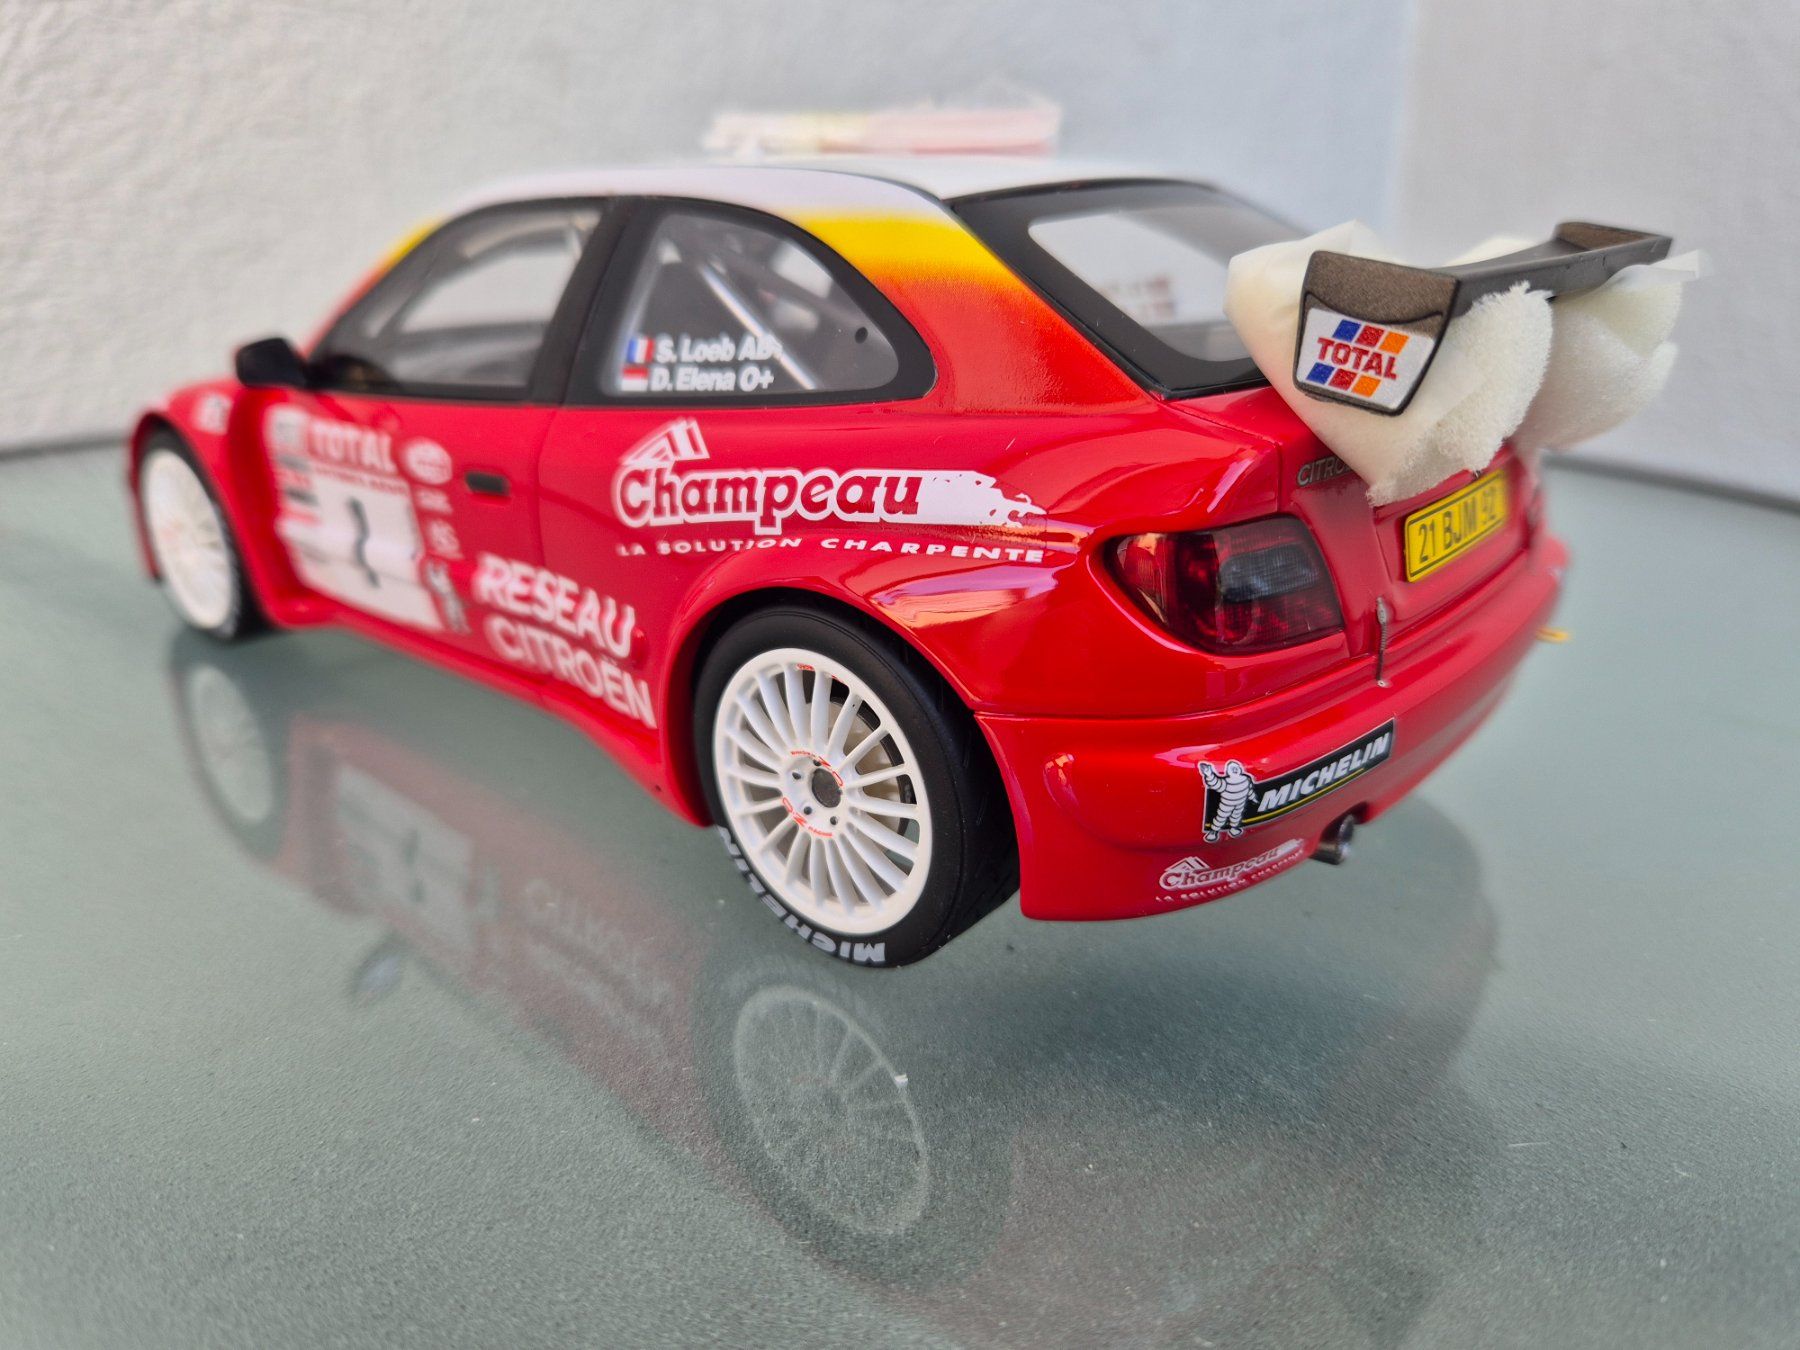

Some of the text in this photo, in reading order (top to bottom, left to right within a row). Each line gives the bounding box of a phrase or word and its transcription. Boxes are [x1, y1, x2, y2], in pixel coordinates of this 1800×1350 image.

[655, 335, 677, 363] S.
[680, 335, 736, 363] Loeb
[1317, 336, 1398, 380] TOTAL
[651, 365, 673, 391] D.
[675, 365, 736, 391] Elena
[308, 419, 399, 475] TOTAL
[1297, 455, 1351, 487] CITRO
[612, 463, 925, 535] Champeau
[618, 537, 1047, 564] LA SOLUTION CHARPENTE
[1418, 519, 1436, 564] 21
[471, 552, 636, 659] RESEAU
[484, 615, 659, 730] CITROËN
[1257, 732, 1391, 812] MICHELIN
